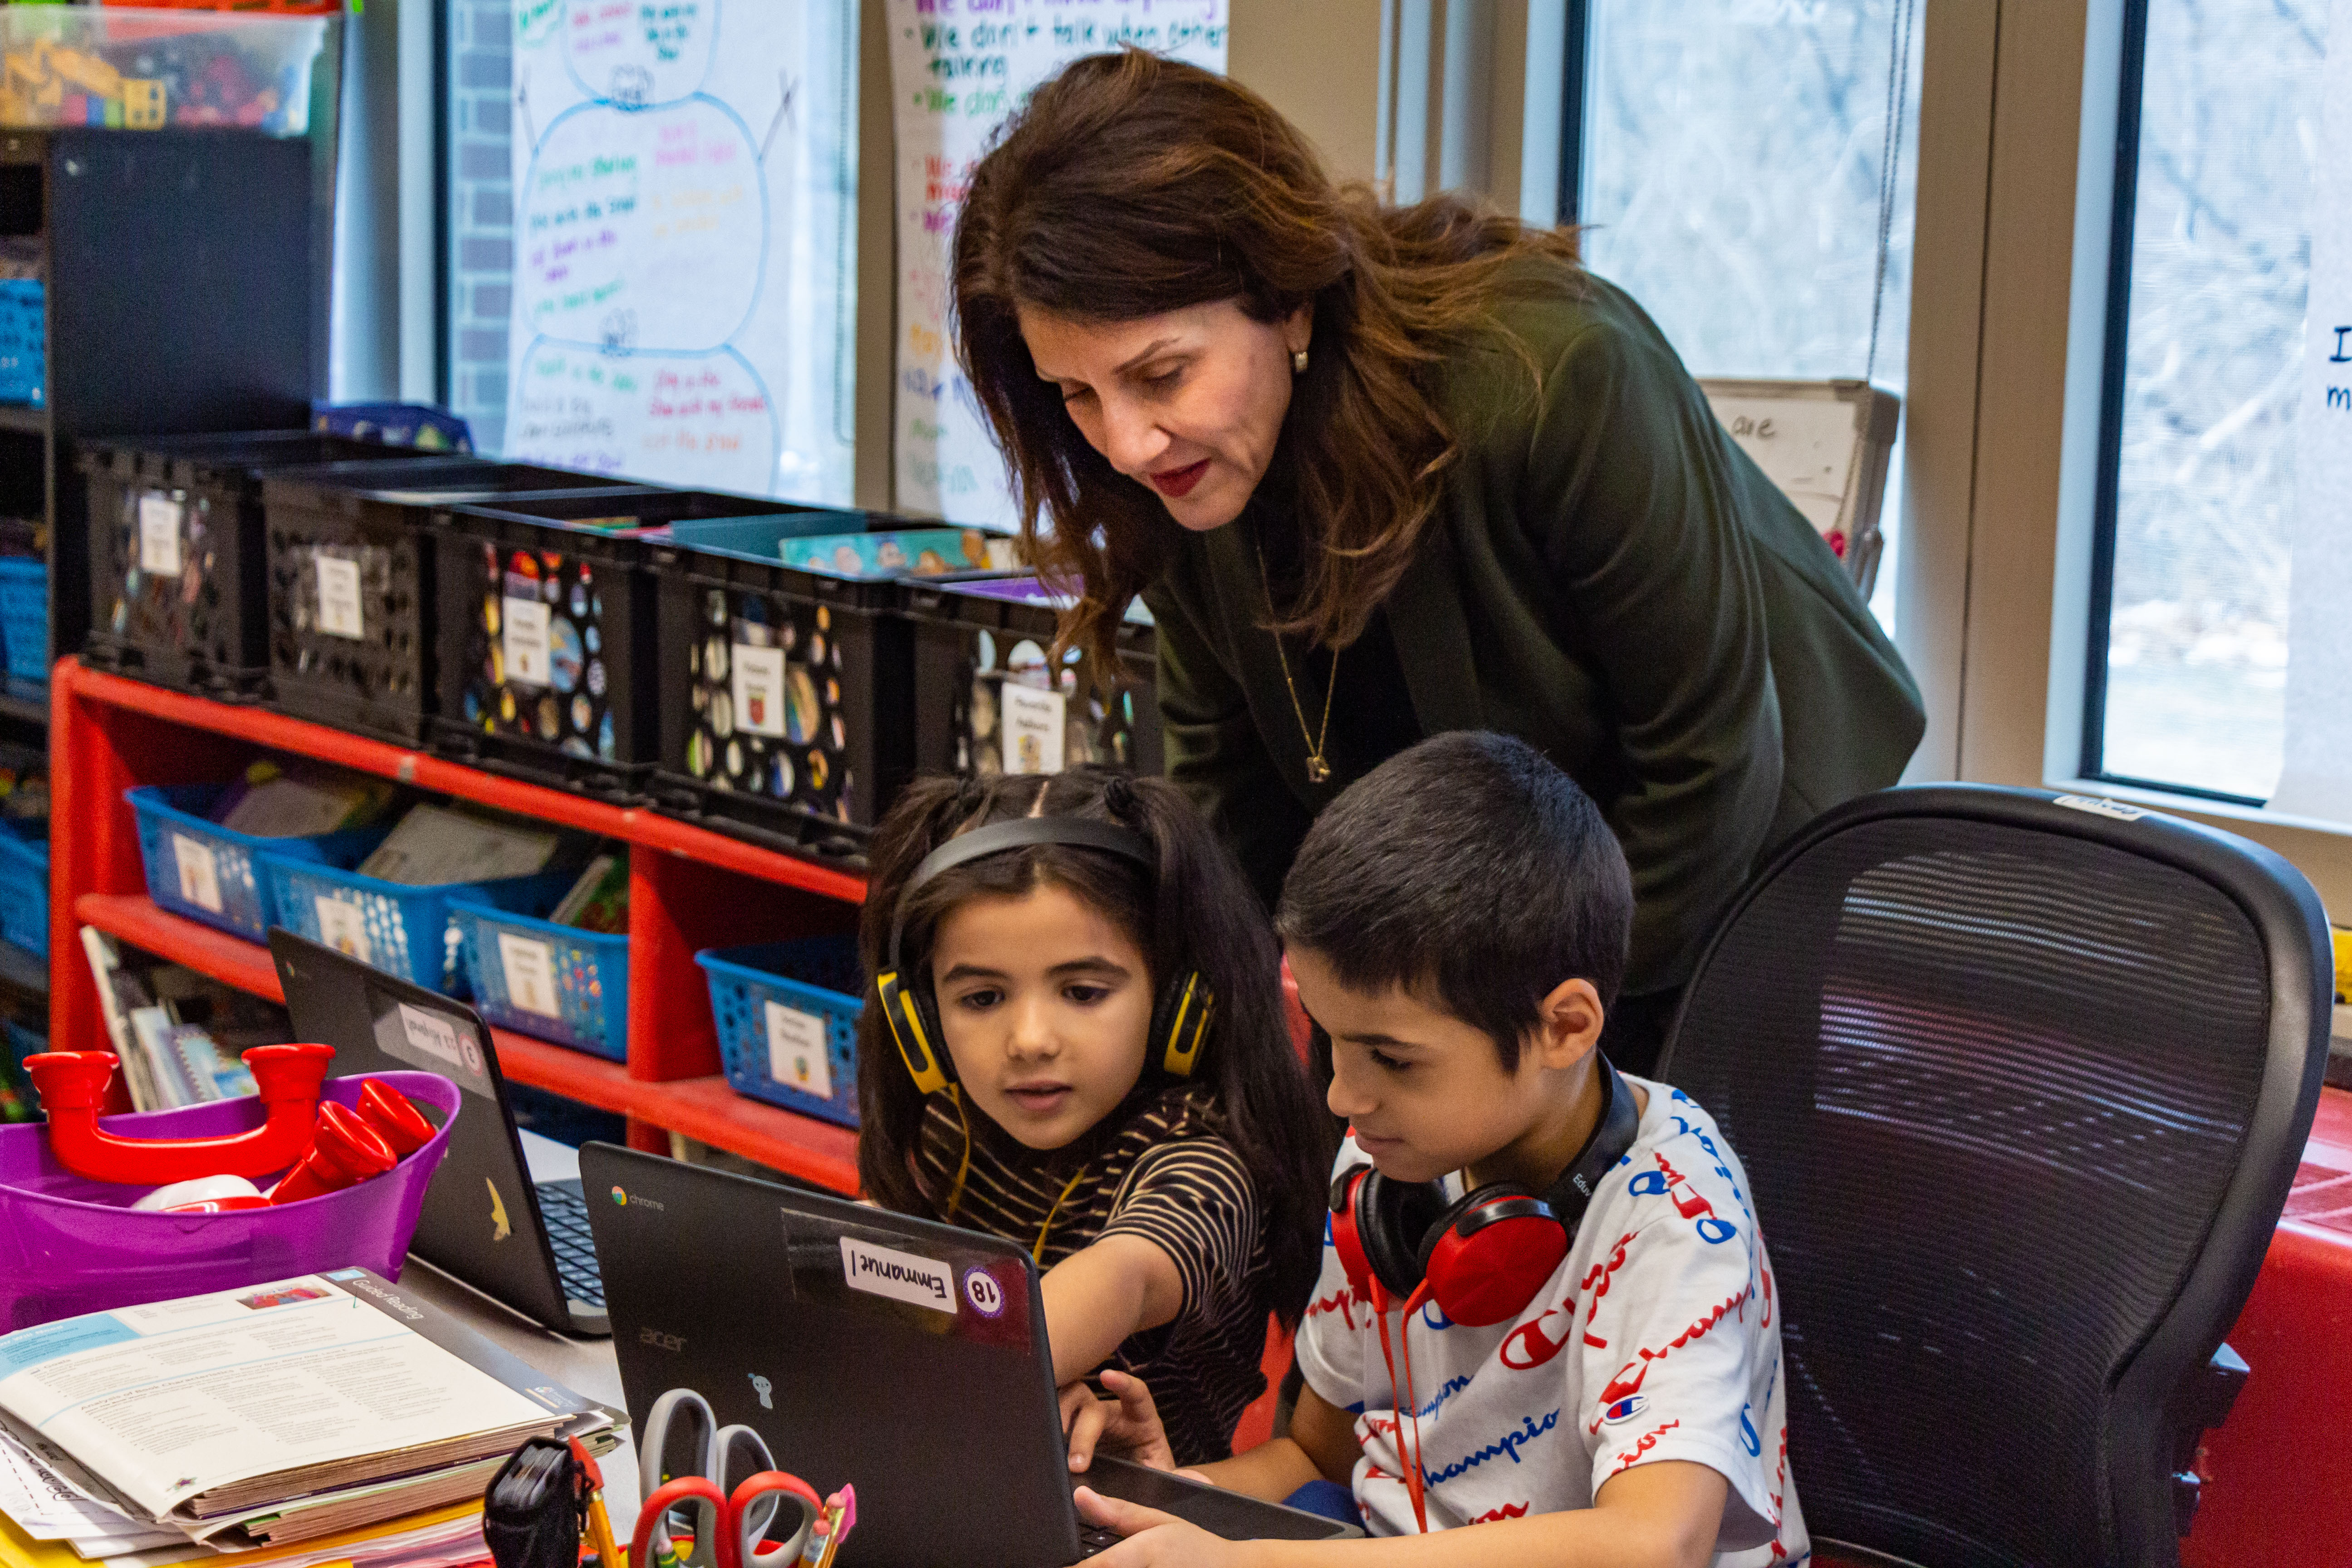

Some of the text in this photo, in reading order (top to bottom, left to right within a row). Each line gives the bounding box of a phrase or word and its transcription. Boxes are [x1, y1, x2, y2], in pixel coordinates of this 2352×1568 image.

[1053, 15, 1095, 46] talk
[1730, 415, 1777, 439] are
[629, 1194, 664, 1211] chrome
[851, 1250, 946, 1299] Emmanuel
[353, 1279, 424, 1320] Guided Reading
[971, 1281, 996, 1303] 18
[640, 1326, 687, 1352] acer
[1412, 1408, 1560, 1487] hampio
